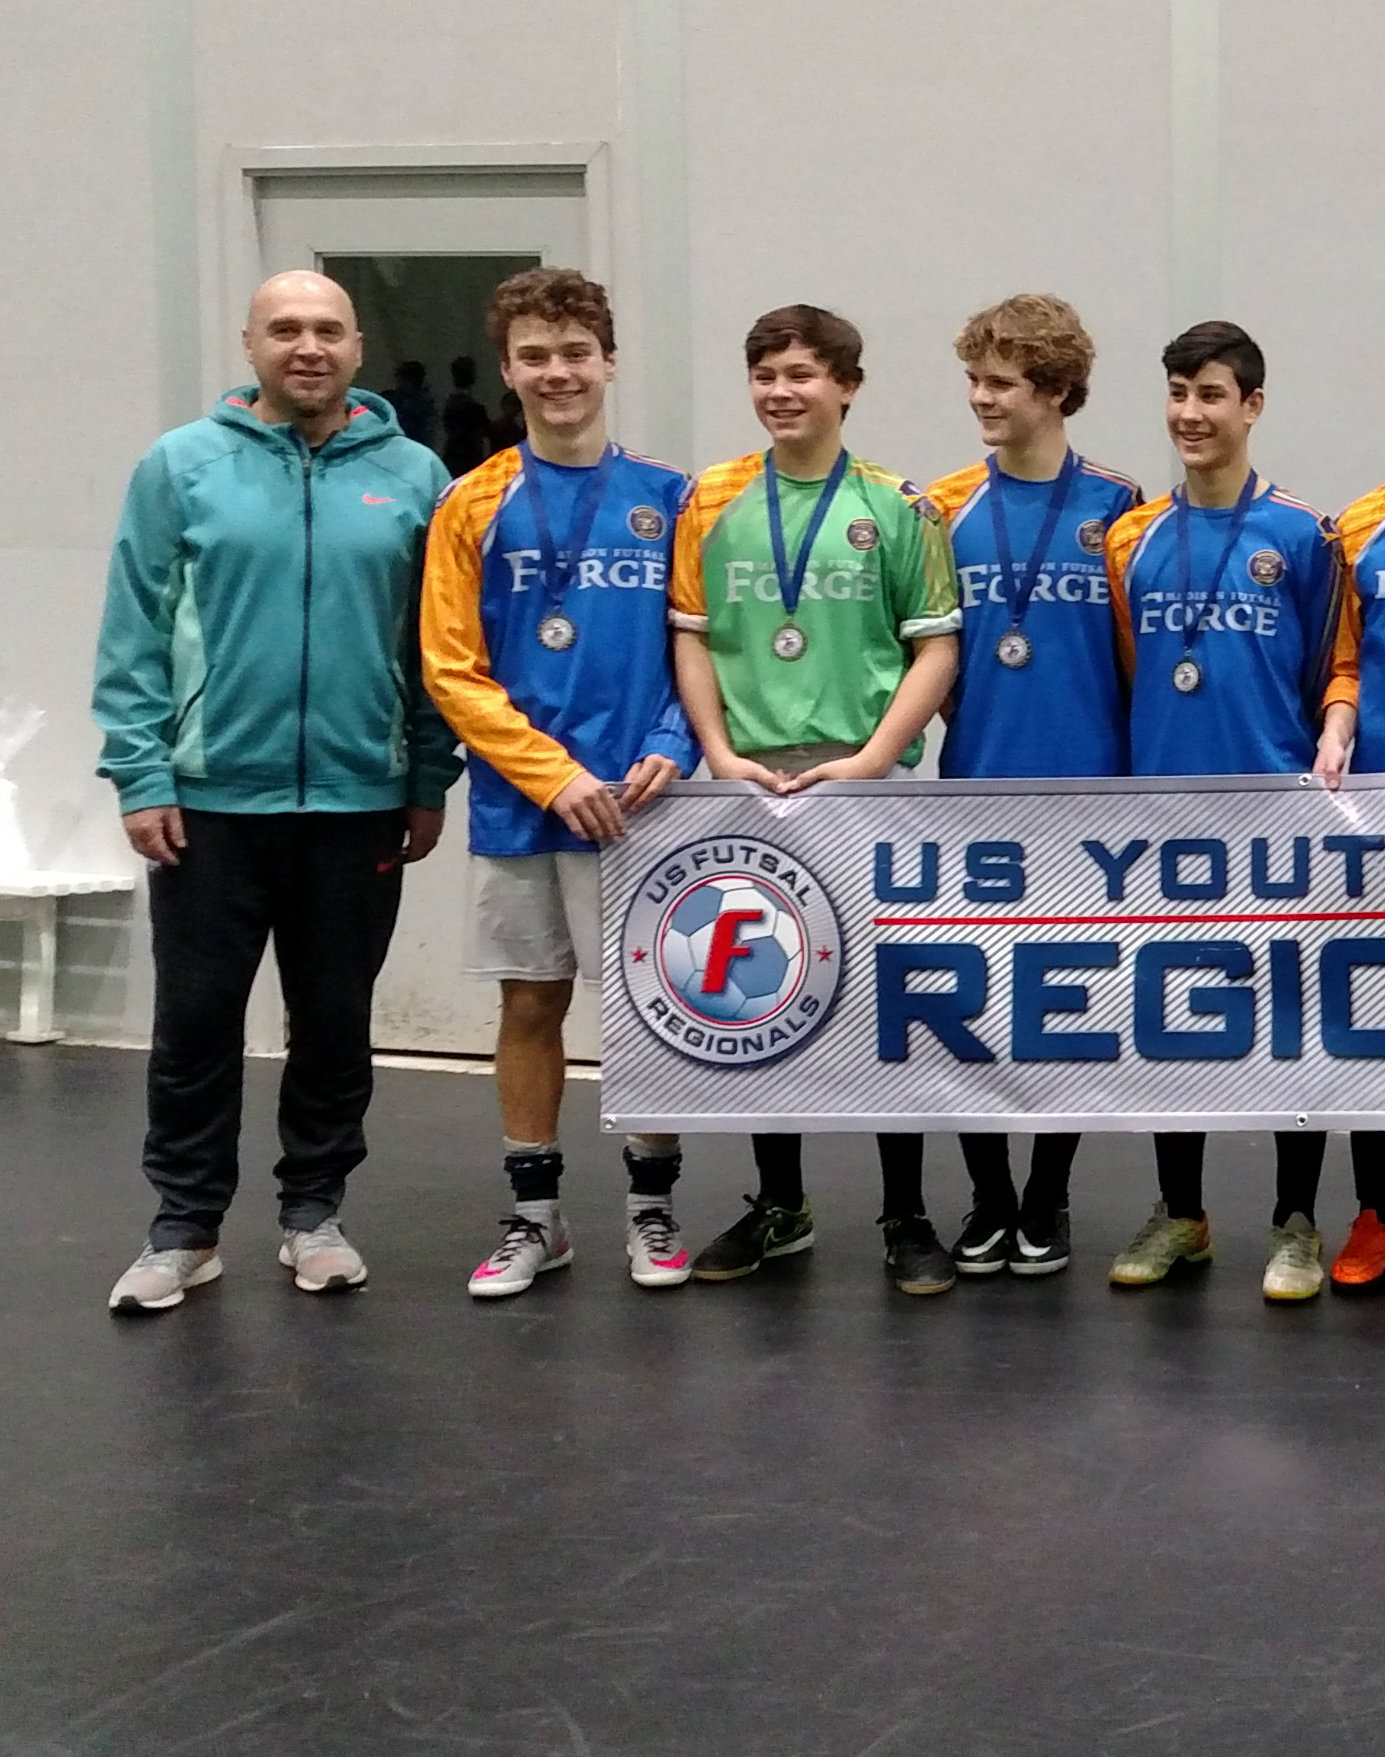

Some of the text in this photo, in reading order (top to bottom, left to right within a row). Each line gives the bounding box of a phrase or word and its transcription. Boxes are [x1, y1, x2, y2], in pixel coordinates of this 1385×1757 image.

[502, 549, 667, 593] FRGE
[646, 844, 815, 909] US FUTSAL
[874, 840, 1027, 903] US
[701, 908, 764, 993] F
[646, 994, 821, 1056] REGIONALS
